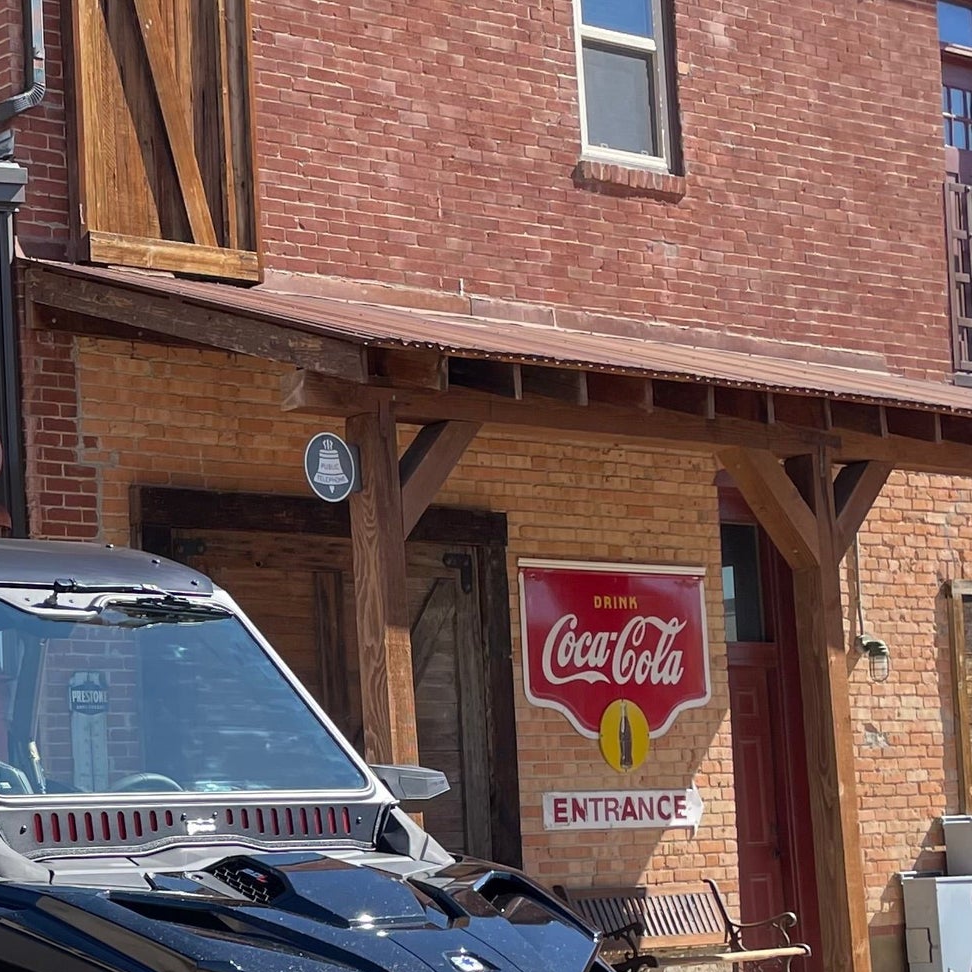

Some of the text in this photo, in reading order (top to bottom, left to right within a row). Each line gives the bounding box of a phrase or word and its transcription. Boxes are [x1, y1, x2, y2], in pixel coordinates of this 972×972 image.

[593, 595, 639, 610] DRINK
[541, 613, 688, 686] Coca-Cola
[71, 690, 109, 703] PRESTONE
[553, 795, 687, 824] ENTRANCE
